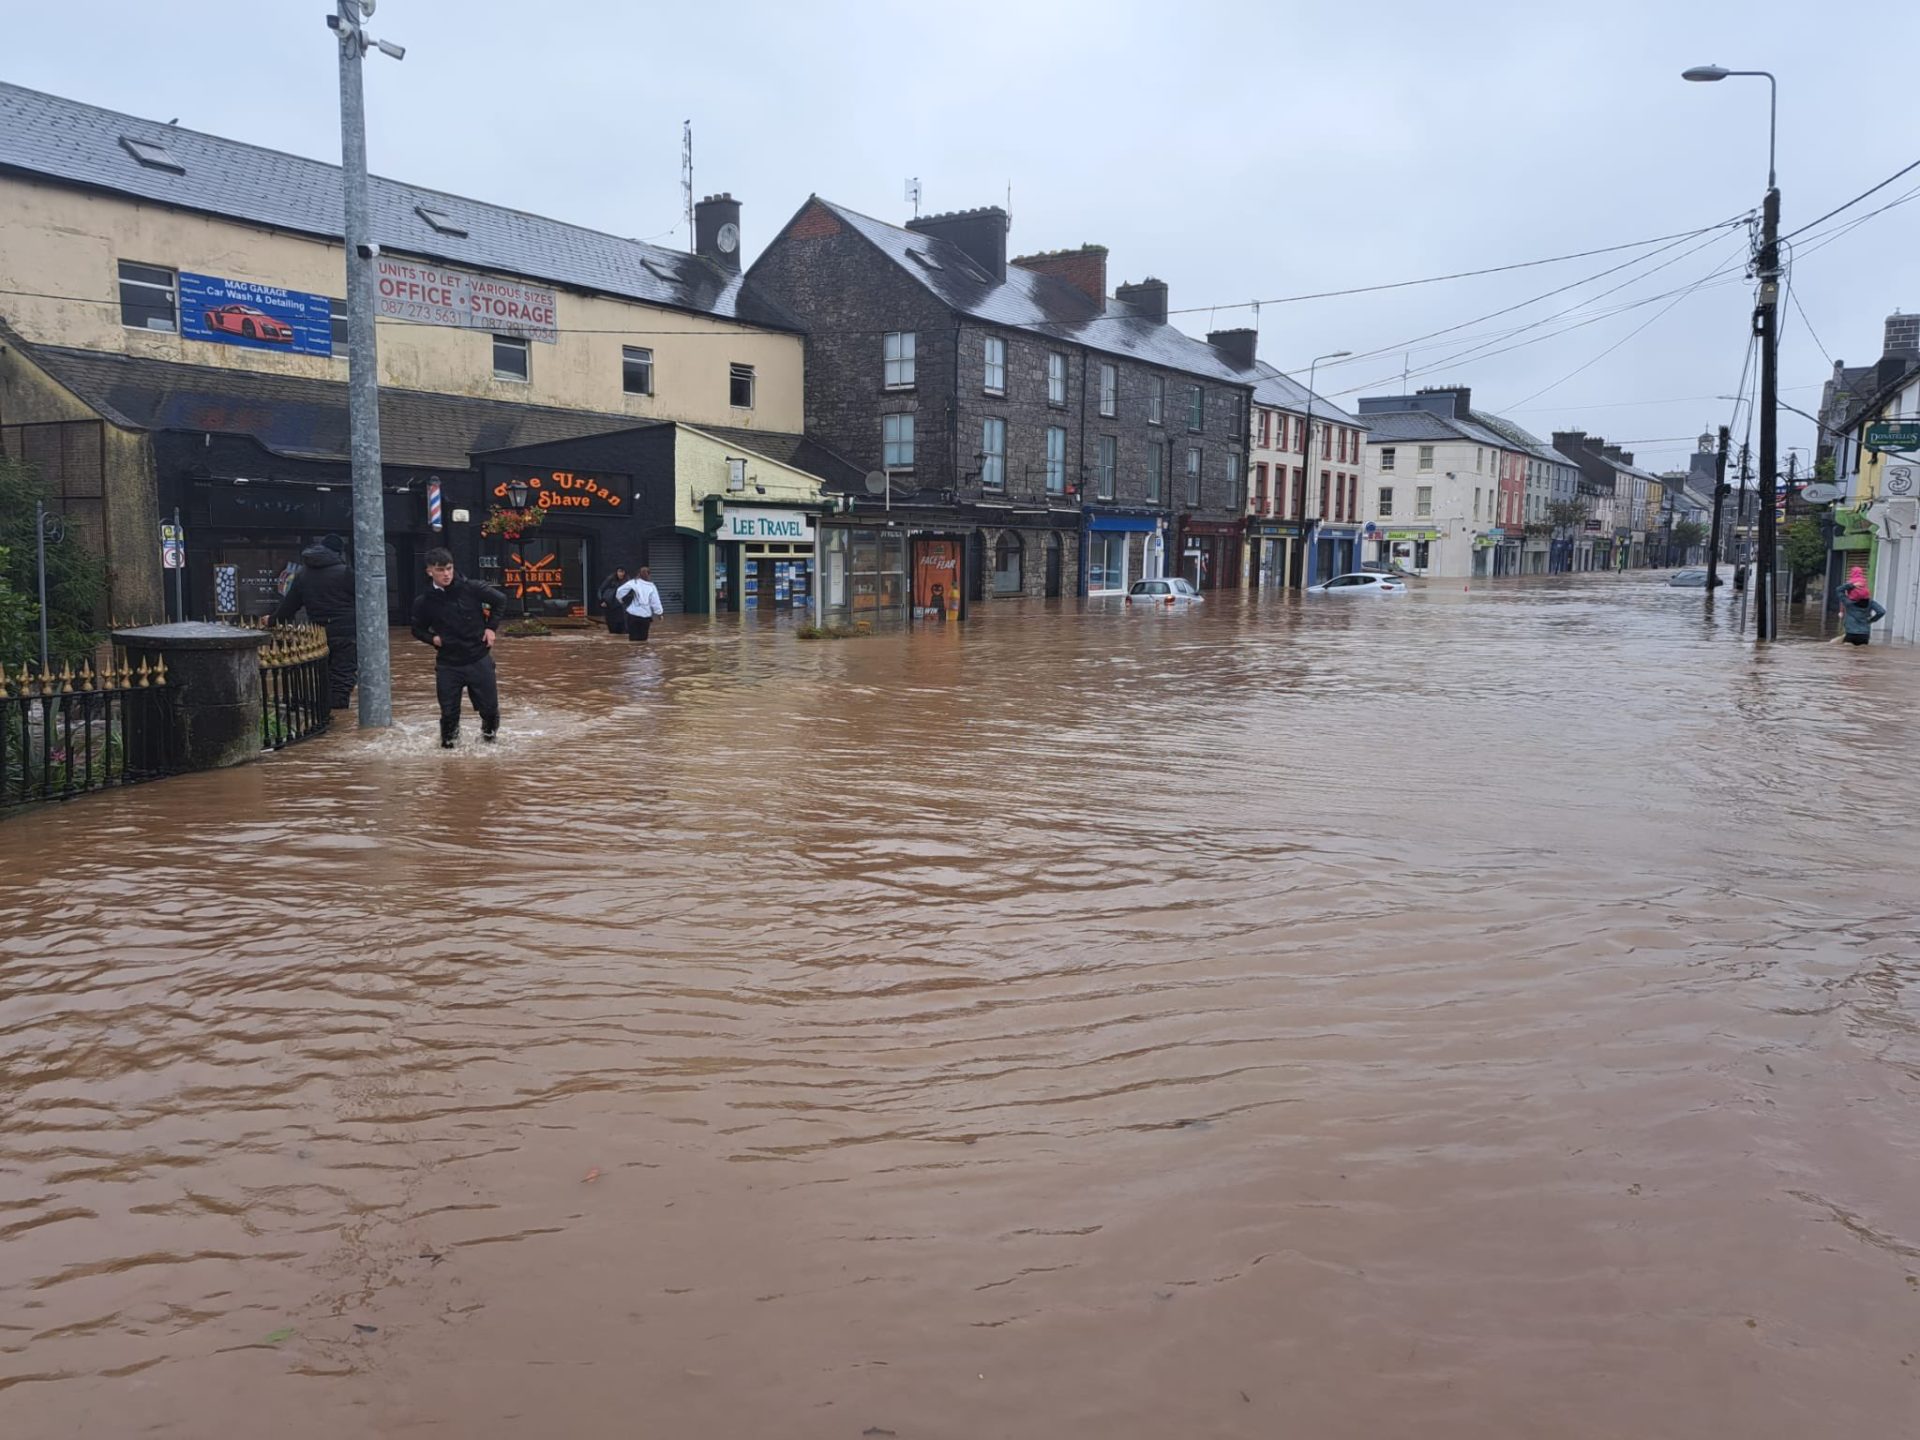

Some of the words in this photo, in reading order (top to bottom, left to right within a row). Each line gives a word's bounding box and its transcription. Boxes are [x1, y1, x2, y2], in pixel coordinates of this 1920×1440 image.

[224, 280, 247, 291] MAG
[249, 284, 288, 298] GARAGE
[379, 262, 416, 279] UNITS
[419, 270, 436, 283] TO
[440, 274, 461, 288] LET
[471, 280, 521, 298] VARIOUS
[524, 291, 553, 306] SIZES
[206, 286, 224, 297] Car
[226, 289, 253, 302] Wash
[255, 295, 263, 303] &
[265, 296, 305, 312] Detailing
[379, 278, 452, 307] OFFICE
[471, 295, 553, 325] STORAGE
[381, 300, 404, 314] 087
[408, 304, 431, 319] 273
[435, 309, 462, 324] 5631
[552, 472, 621, 506] Urban
[1888, 467, 1912, 493] 3
[538, 490, 590, 508] Shave
[733, 517, 754, 535] LEE
[758, 518, 802, 536] TRAVEL
